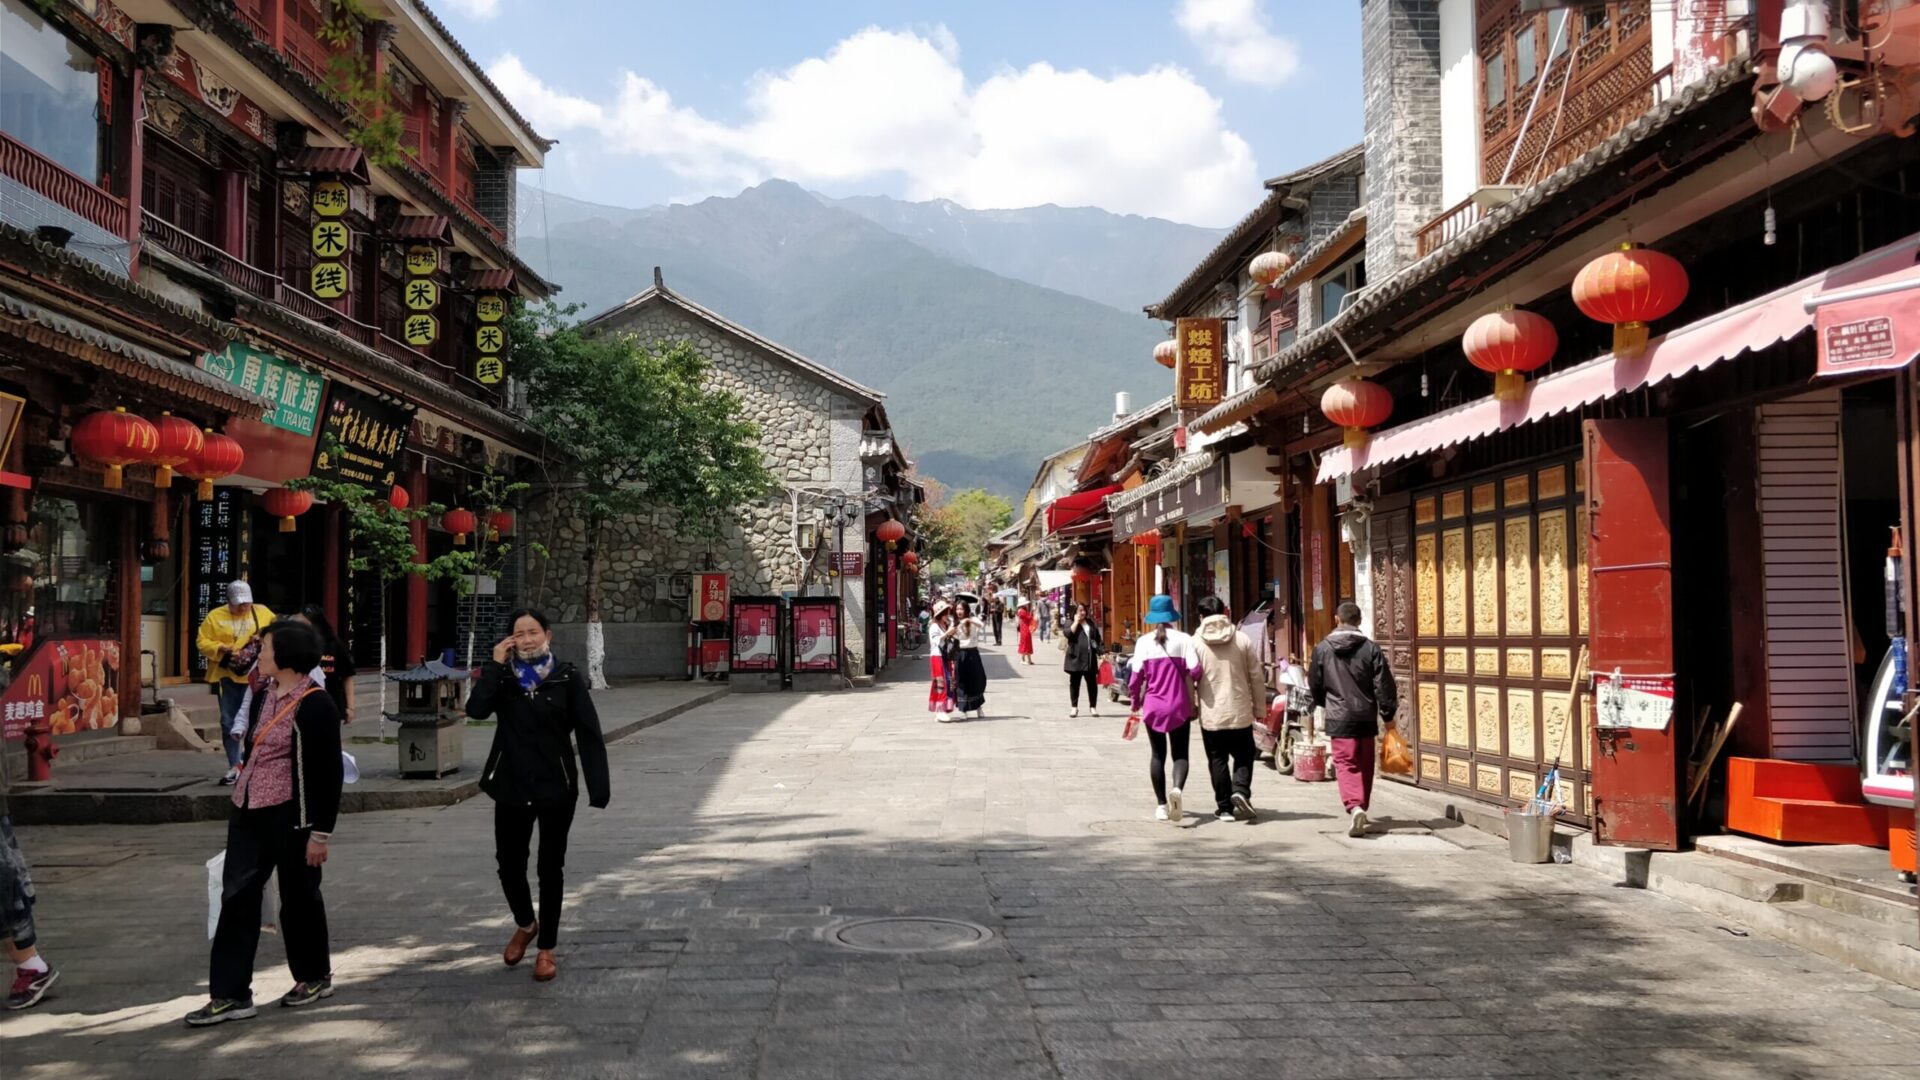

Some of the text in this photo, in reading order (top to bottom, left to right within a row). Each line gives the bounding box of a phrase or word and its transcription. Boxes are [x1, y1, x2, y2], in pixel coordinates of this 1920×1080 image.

[241, 354, 321, 414] 康辉旅游
[1188, 329, 1212, 400] 烘焙工坊
[282, 409, 311, 432] TRAVEL
[4, 700, 45, 721] 麦趣鸡盒
